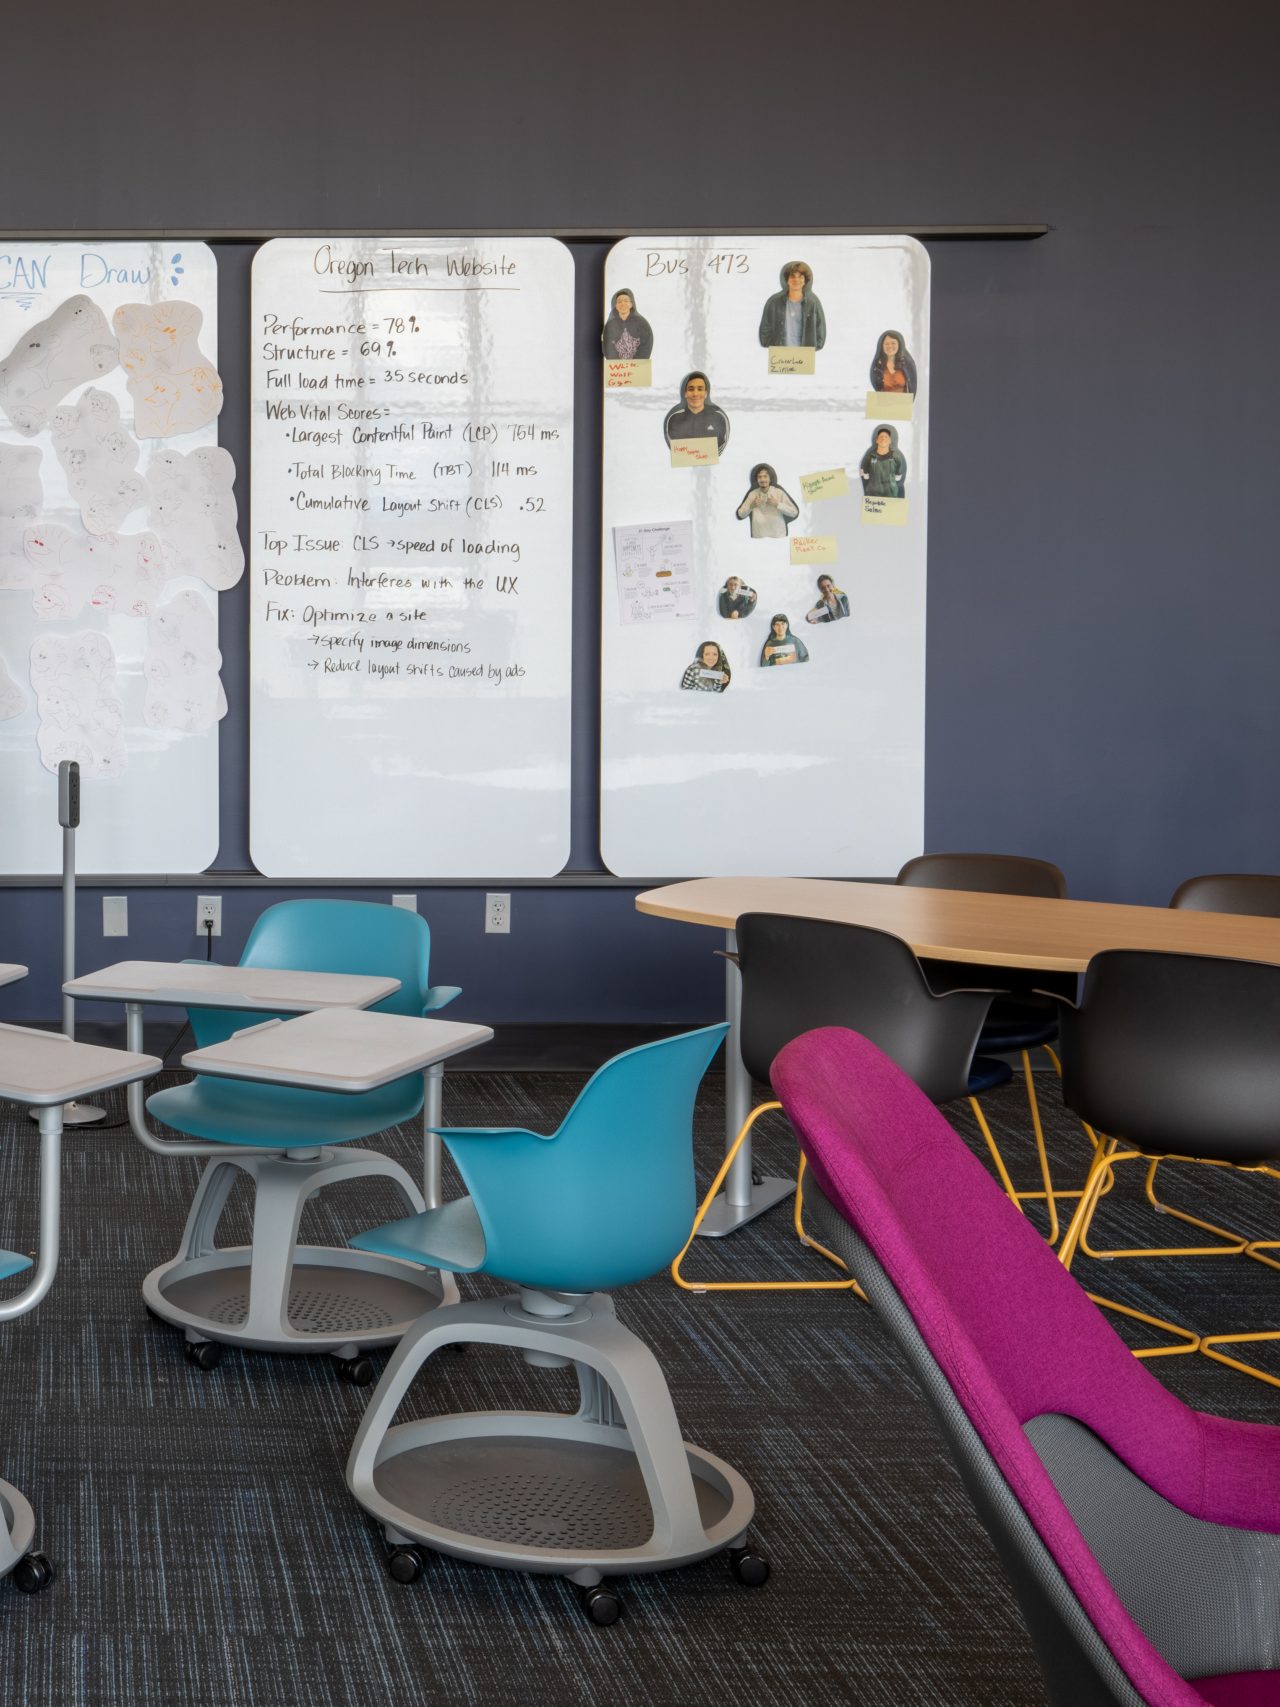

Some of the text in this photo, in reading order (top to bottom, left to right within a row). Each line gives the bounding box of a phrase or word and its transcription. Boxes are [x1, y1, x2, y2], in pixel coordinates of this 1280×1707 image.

[80, 254, 151, 288] Draw
[314, 245, 516, 284] Oregon Tech Website
[708, 254, 749, 274] 473
[263, 315, 365, 343] Performance
[263, 343, 335, 361] Structure
[267, 369, 468, 389] Full load time seconds
[266, 400, 330, 420] Web Vital
[291, 423, 497, 446] Largest Contentful Paint (LCP)
[292, 462, 324, 478] Total
[332, 464, 381, 485] Blocking
[386, 463, 416, 480] Time
[516, 465, 537, 476] ms
[296, 491, 503, 518] Cumulative Layout (CLS)
[259, 532, 520, 562] Top CLS speed of loading
[347, 567, 519, 594] Interferes with the UX
[266, 601, 426, 627] Fix: Optimize site
[371, 637, 402, 651] image
[407, 637, 471, 653] dimensions
[325, 658, 526, 685] Reduce layout caused by ads
